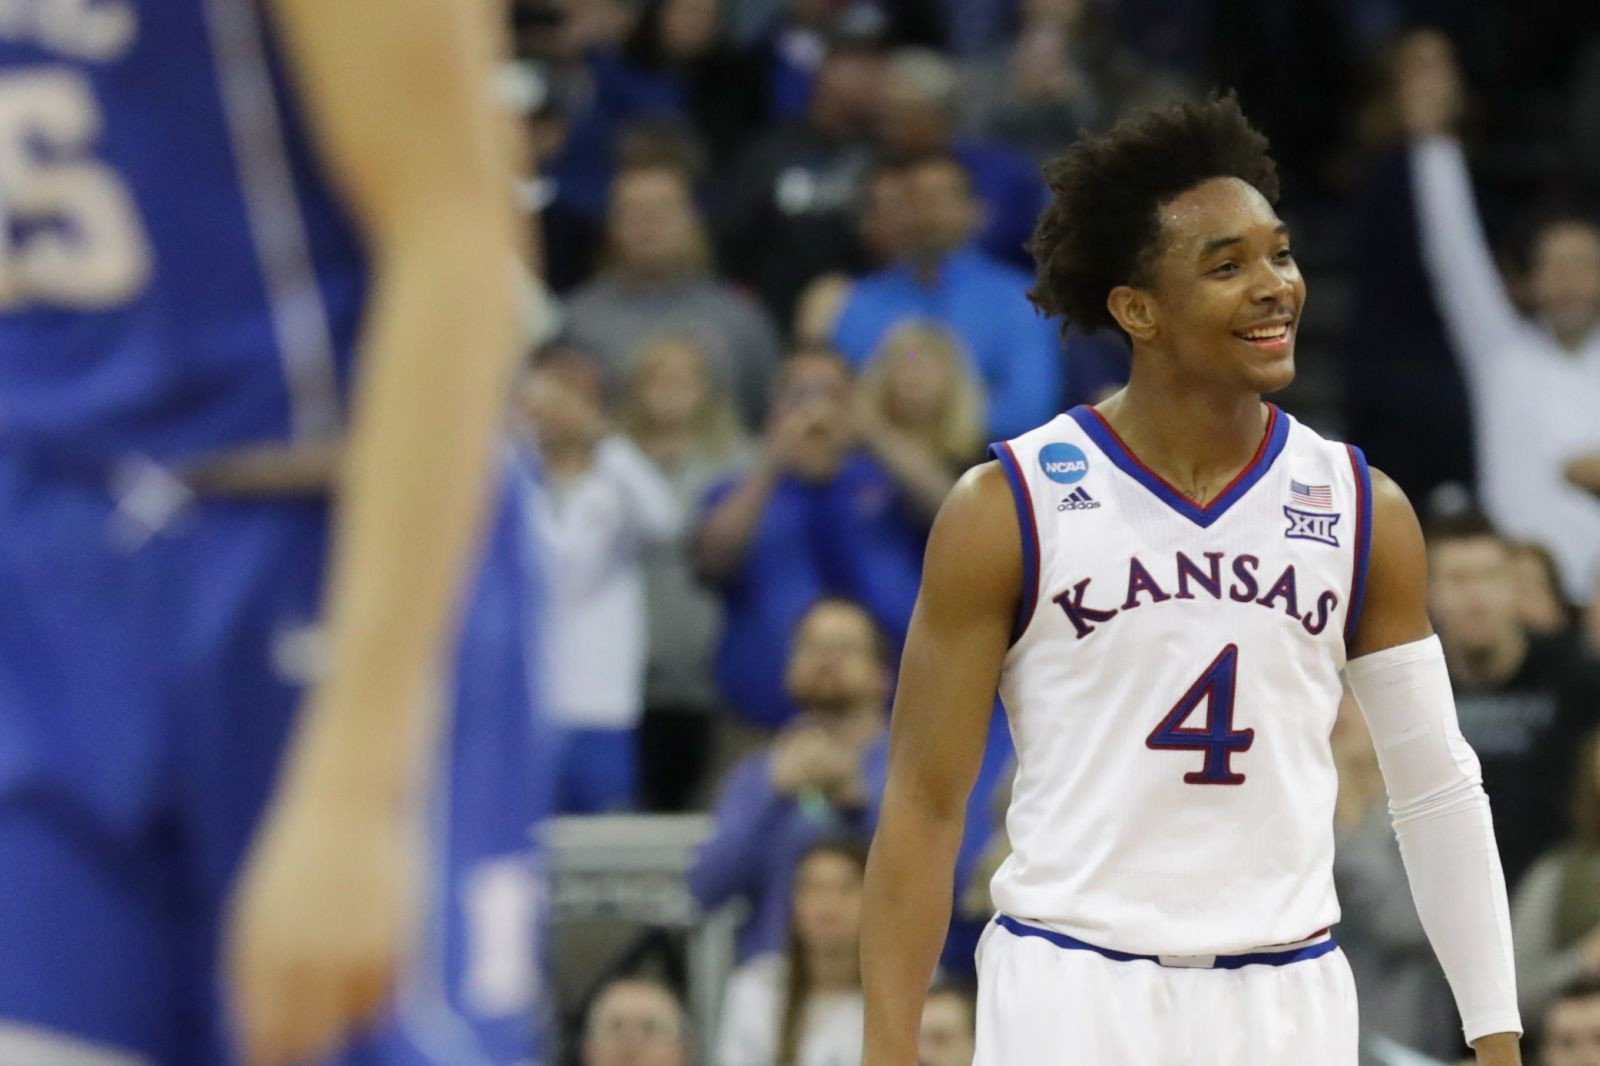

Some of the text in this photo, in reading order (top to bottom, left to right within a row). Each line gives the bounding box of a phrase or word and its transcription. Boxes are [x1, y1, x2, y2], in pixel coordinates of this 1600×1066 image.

[1046, 460, 1087, 473] NCAA
[1057, 500, 1101, 512] adidas
[1052, 551, 1338, 639] KANSAS
[1146, 643, 1254, 785] 4
